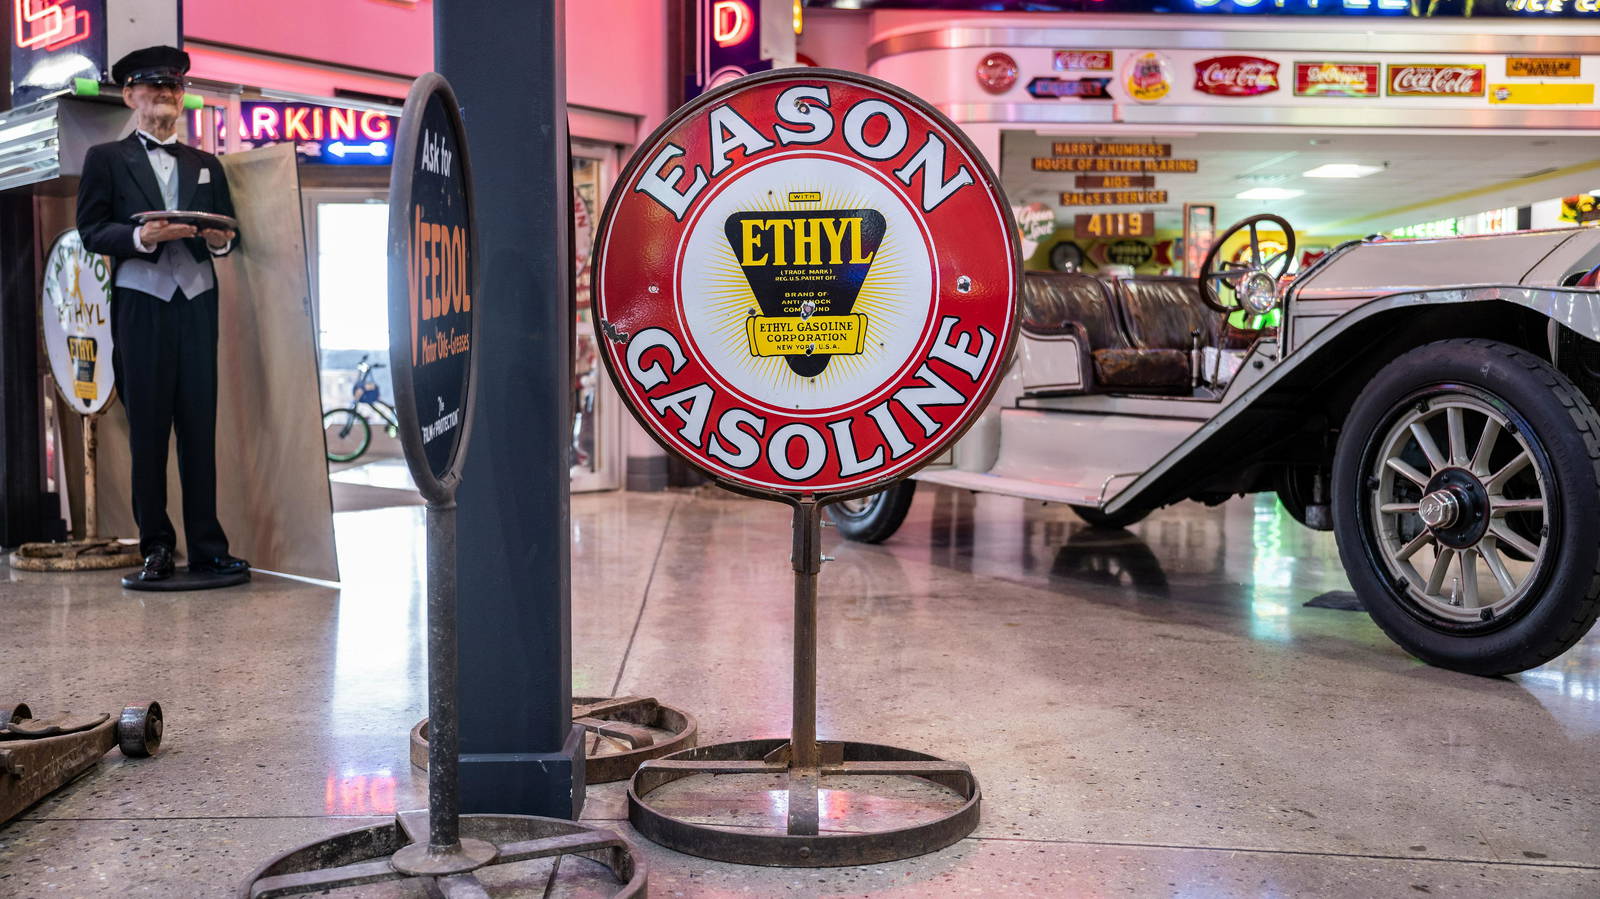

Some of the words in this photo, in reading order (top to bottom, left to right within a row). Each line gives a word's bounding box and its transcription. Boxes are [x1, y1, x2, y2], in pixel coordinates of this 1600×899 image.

[1392, 66, 1479, 93] Coca-Cola
[421, 128, 440, 175] Ask
[441, 136, 452, 178] for
[634, 85, 975, 222] EASON
[1035, 158, 1073, 171] HOUSE
[1077, 159, 1093, 171] OF
[1096, 159, 1142, 171] BETTER
[1102, 176, 1130, 188] AIDS
[1116, 191, 1165, 204] SERVICE
[1087, 213, 1144, 237] 4119
[739, 217, 874, 267] ETHYL
[407, 203, 471, 367] VEEDOL
[759, 322, 794, 333] ETHYL
[796, 321, 854, 332] GASOLINE
[766, 332, 848, 343] CORPORATION
[625, 315, 997, 482] GASOLINE
